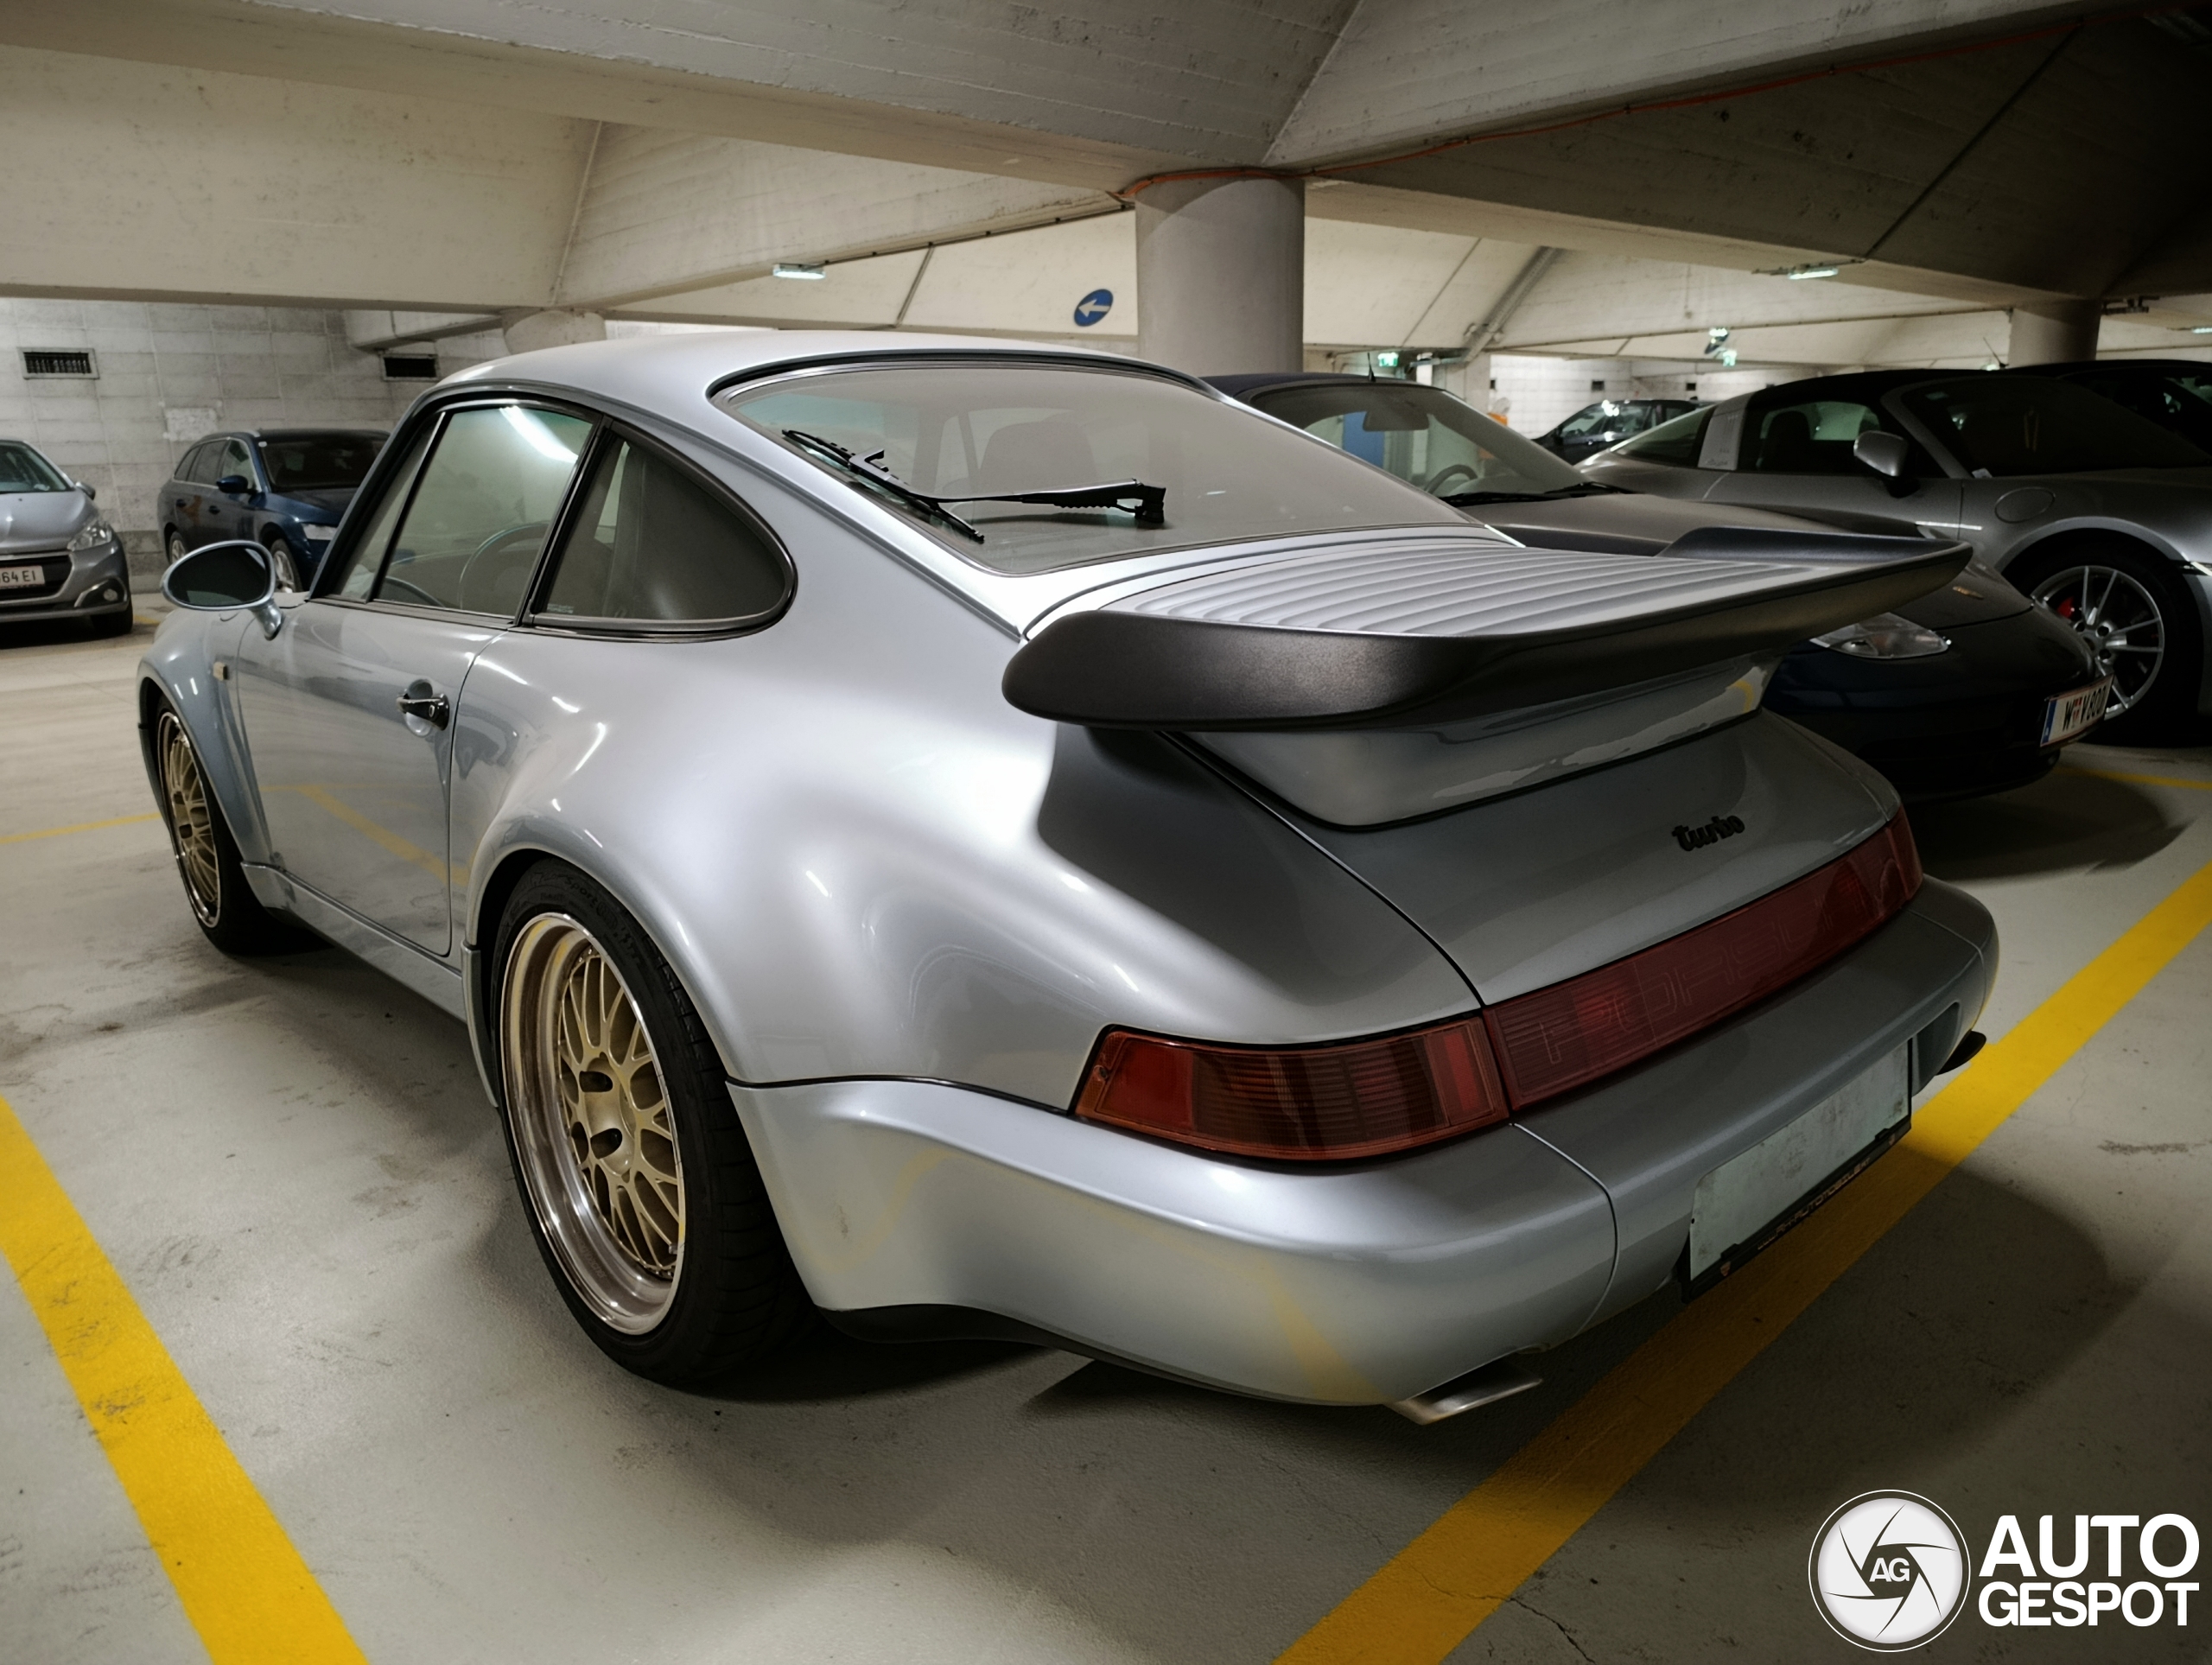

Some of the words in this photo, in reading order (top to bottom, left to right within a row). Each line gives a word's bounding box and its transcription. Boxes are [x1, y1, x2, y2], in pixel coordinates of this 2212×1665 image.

[0, 571, 18, 583] 64
[1671, 815, 1745, 852] turbo
[1538, 859, 1884, 1064] PORSCH
